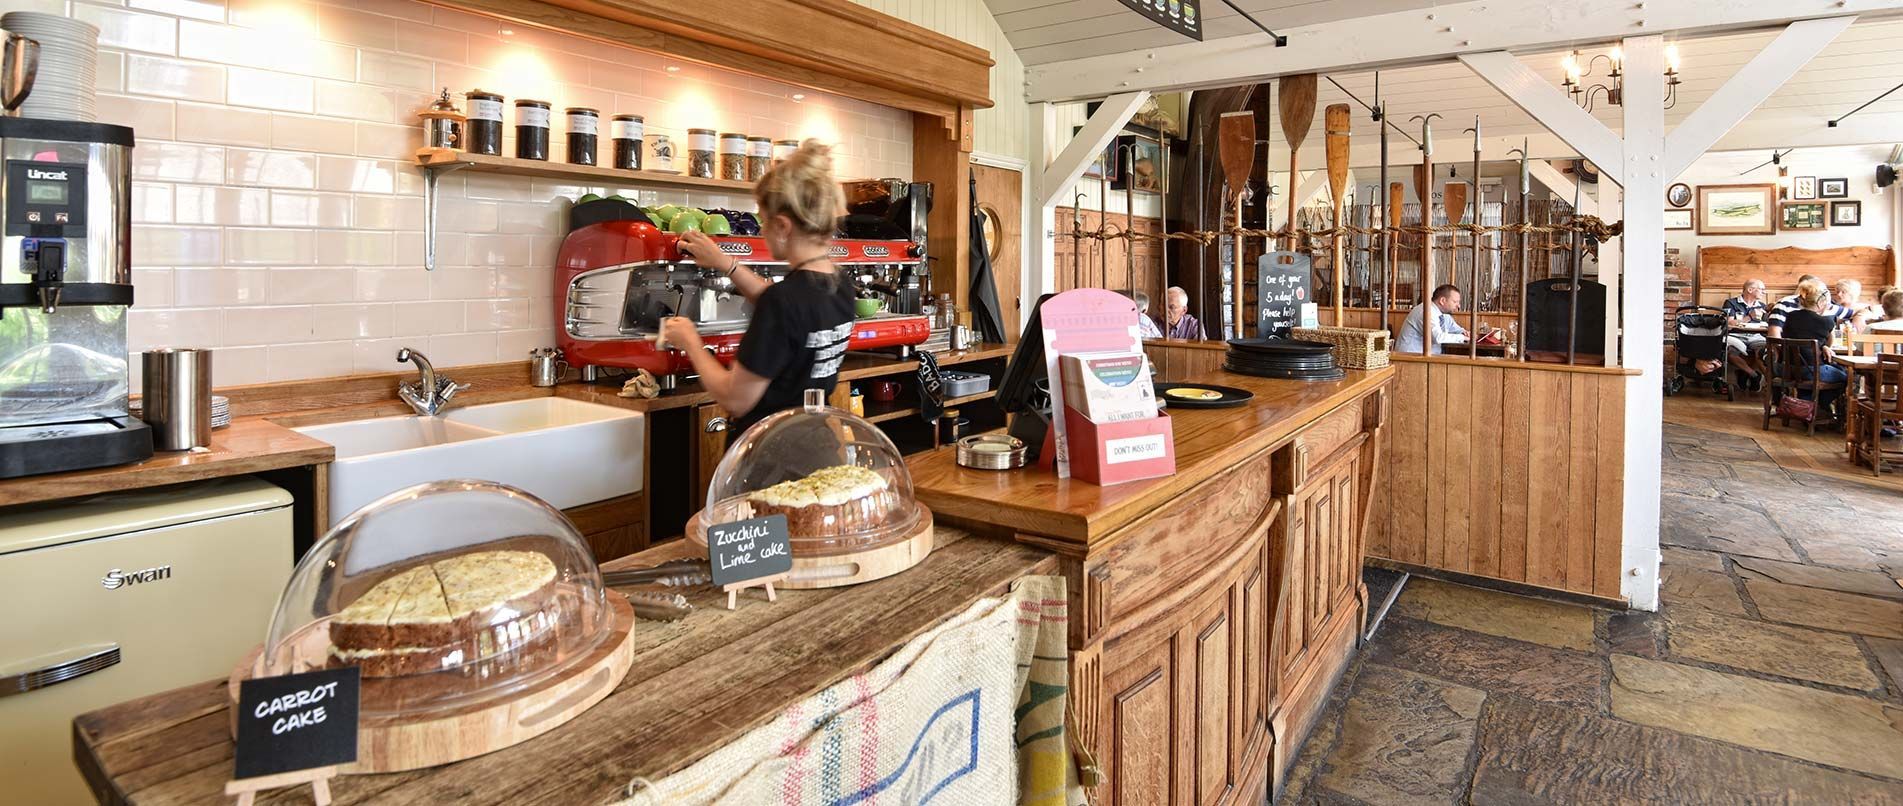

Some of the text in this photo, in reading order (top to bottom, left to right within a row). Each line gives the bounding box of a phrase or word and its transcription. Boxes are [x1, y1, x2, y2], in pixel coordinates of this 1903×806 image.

[27, 169, 68, 180] Lincat
[1266, 274, 1302, 288] One of your
[1266, 291, 1273, 303] 5
[1280, 289, 1295, 305] day!
[1262, 306, 1295, 320] Please help
[1114, 445, 1131, 456] DON'T
[1132, 444, 1145, 454] MISS
[714, 520, 770, 546] Zucchini
[737, 538, 755, 552] and
[720, 542, 788, 570] Lime cake
[101, 565, 171, 590] Swan
[254, 681, 338, 718] CARROT
[272, 706, 327, 735] CAKE
